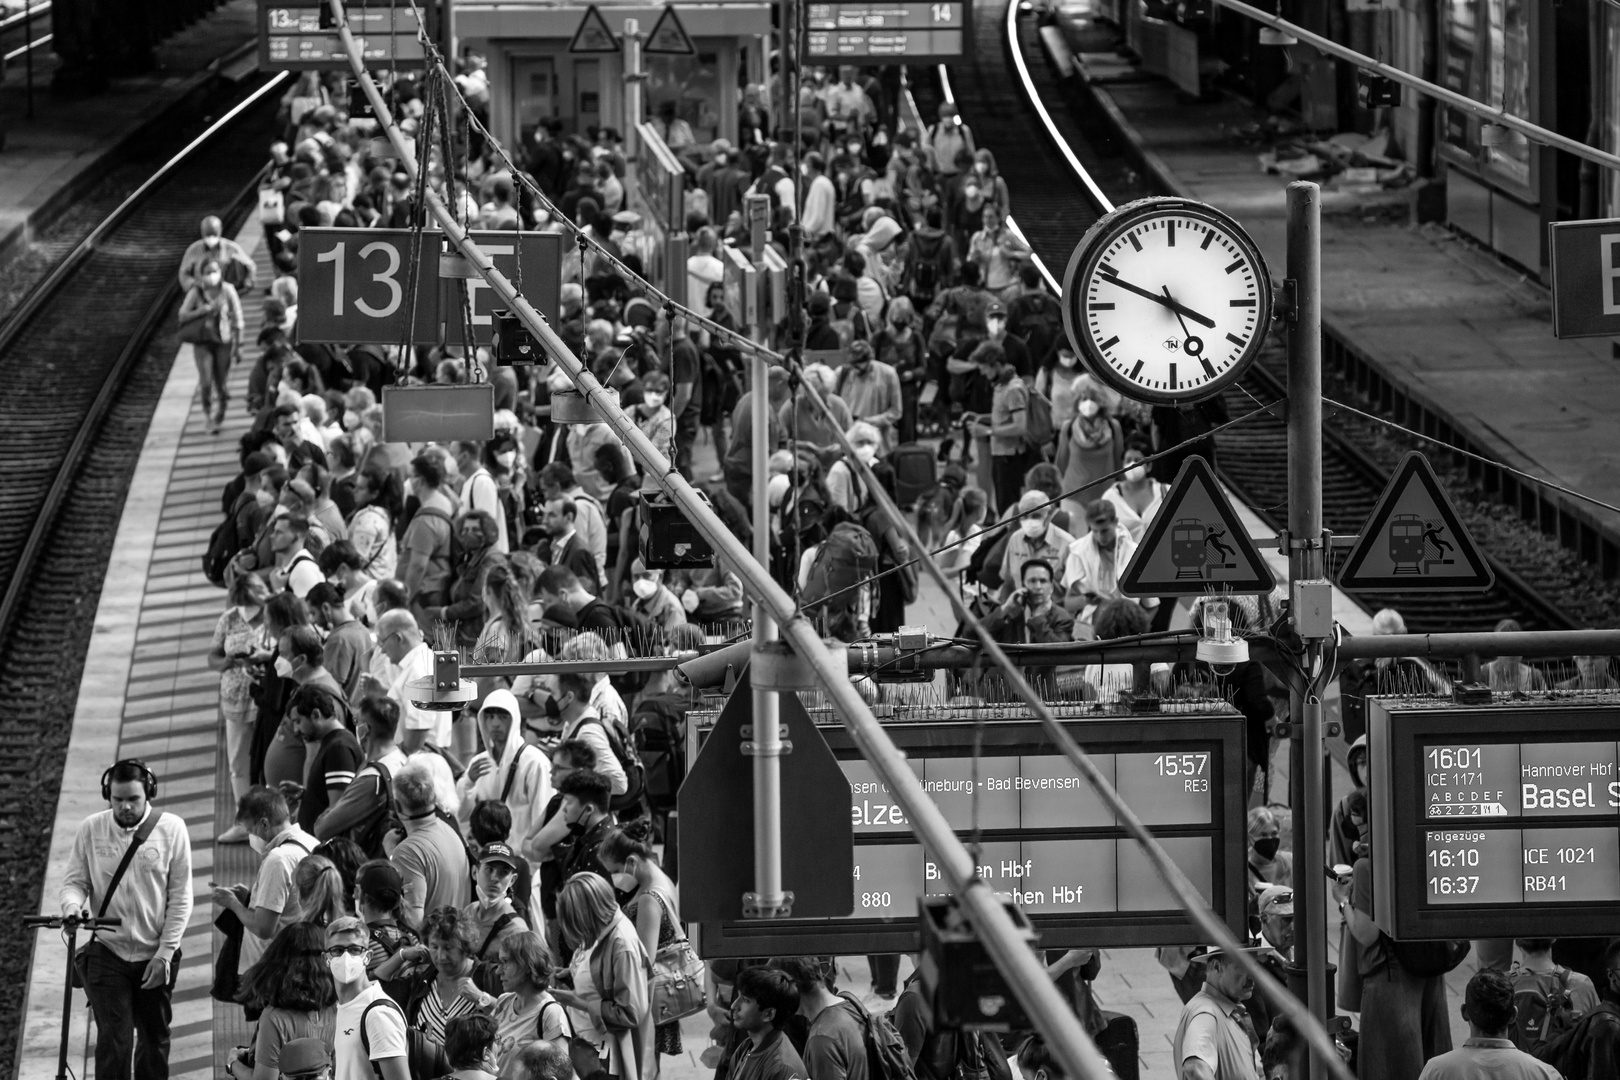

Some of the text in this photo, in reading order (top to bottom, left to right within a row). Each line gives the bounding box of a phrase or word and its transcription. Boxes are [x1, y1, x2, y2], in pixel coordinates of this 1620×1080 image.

[269, 9, 290, 28] 13
[931, 3, 952, 22] 14
[317, 241, 403, 318] 13
[1165, 340, 1179, 349] TN
[1153, 754, 1208, 776] 15:57
[1428, 747, 1481, 769] 16:01
[1427, 772, 1483, 787] ICE 1171
[1521, 762, 1613, 778] Hannover Hbf
[919, 778, 974, 795] üneburg
[987, 777, 1011, 791] Bad
[1015, 776, 1080, 790] Bevensen
[1184, 779, 1208, 793] RE3
[1431, 791, 1503, 802] A B C D E F
[1522, 782, 1596, 809] Basel
[851, 799, 909, 826] elze
[1445, 805, 1452, 815] 2
[1458, 805, 1465, 815] 2
[1471, 805, 1478, 815] 2
[1426, 830, 1486, 843] Folgezüge
[1428, 847, 1595, 868] 16:10 ICE 1021
[1001, 859, 1032, 878] Hbf
[1429, 875, 1566, 895] 16:37 RB41
[861, 891, 891, 908] 880
[1052, 885, 1083, 903] Hbf
